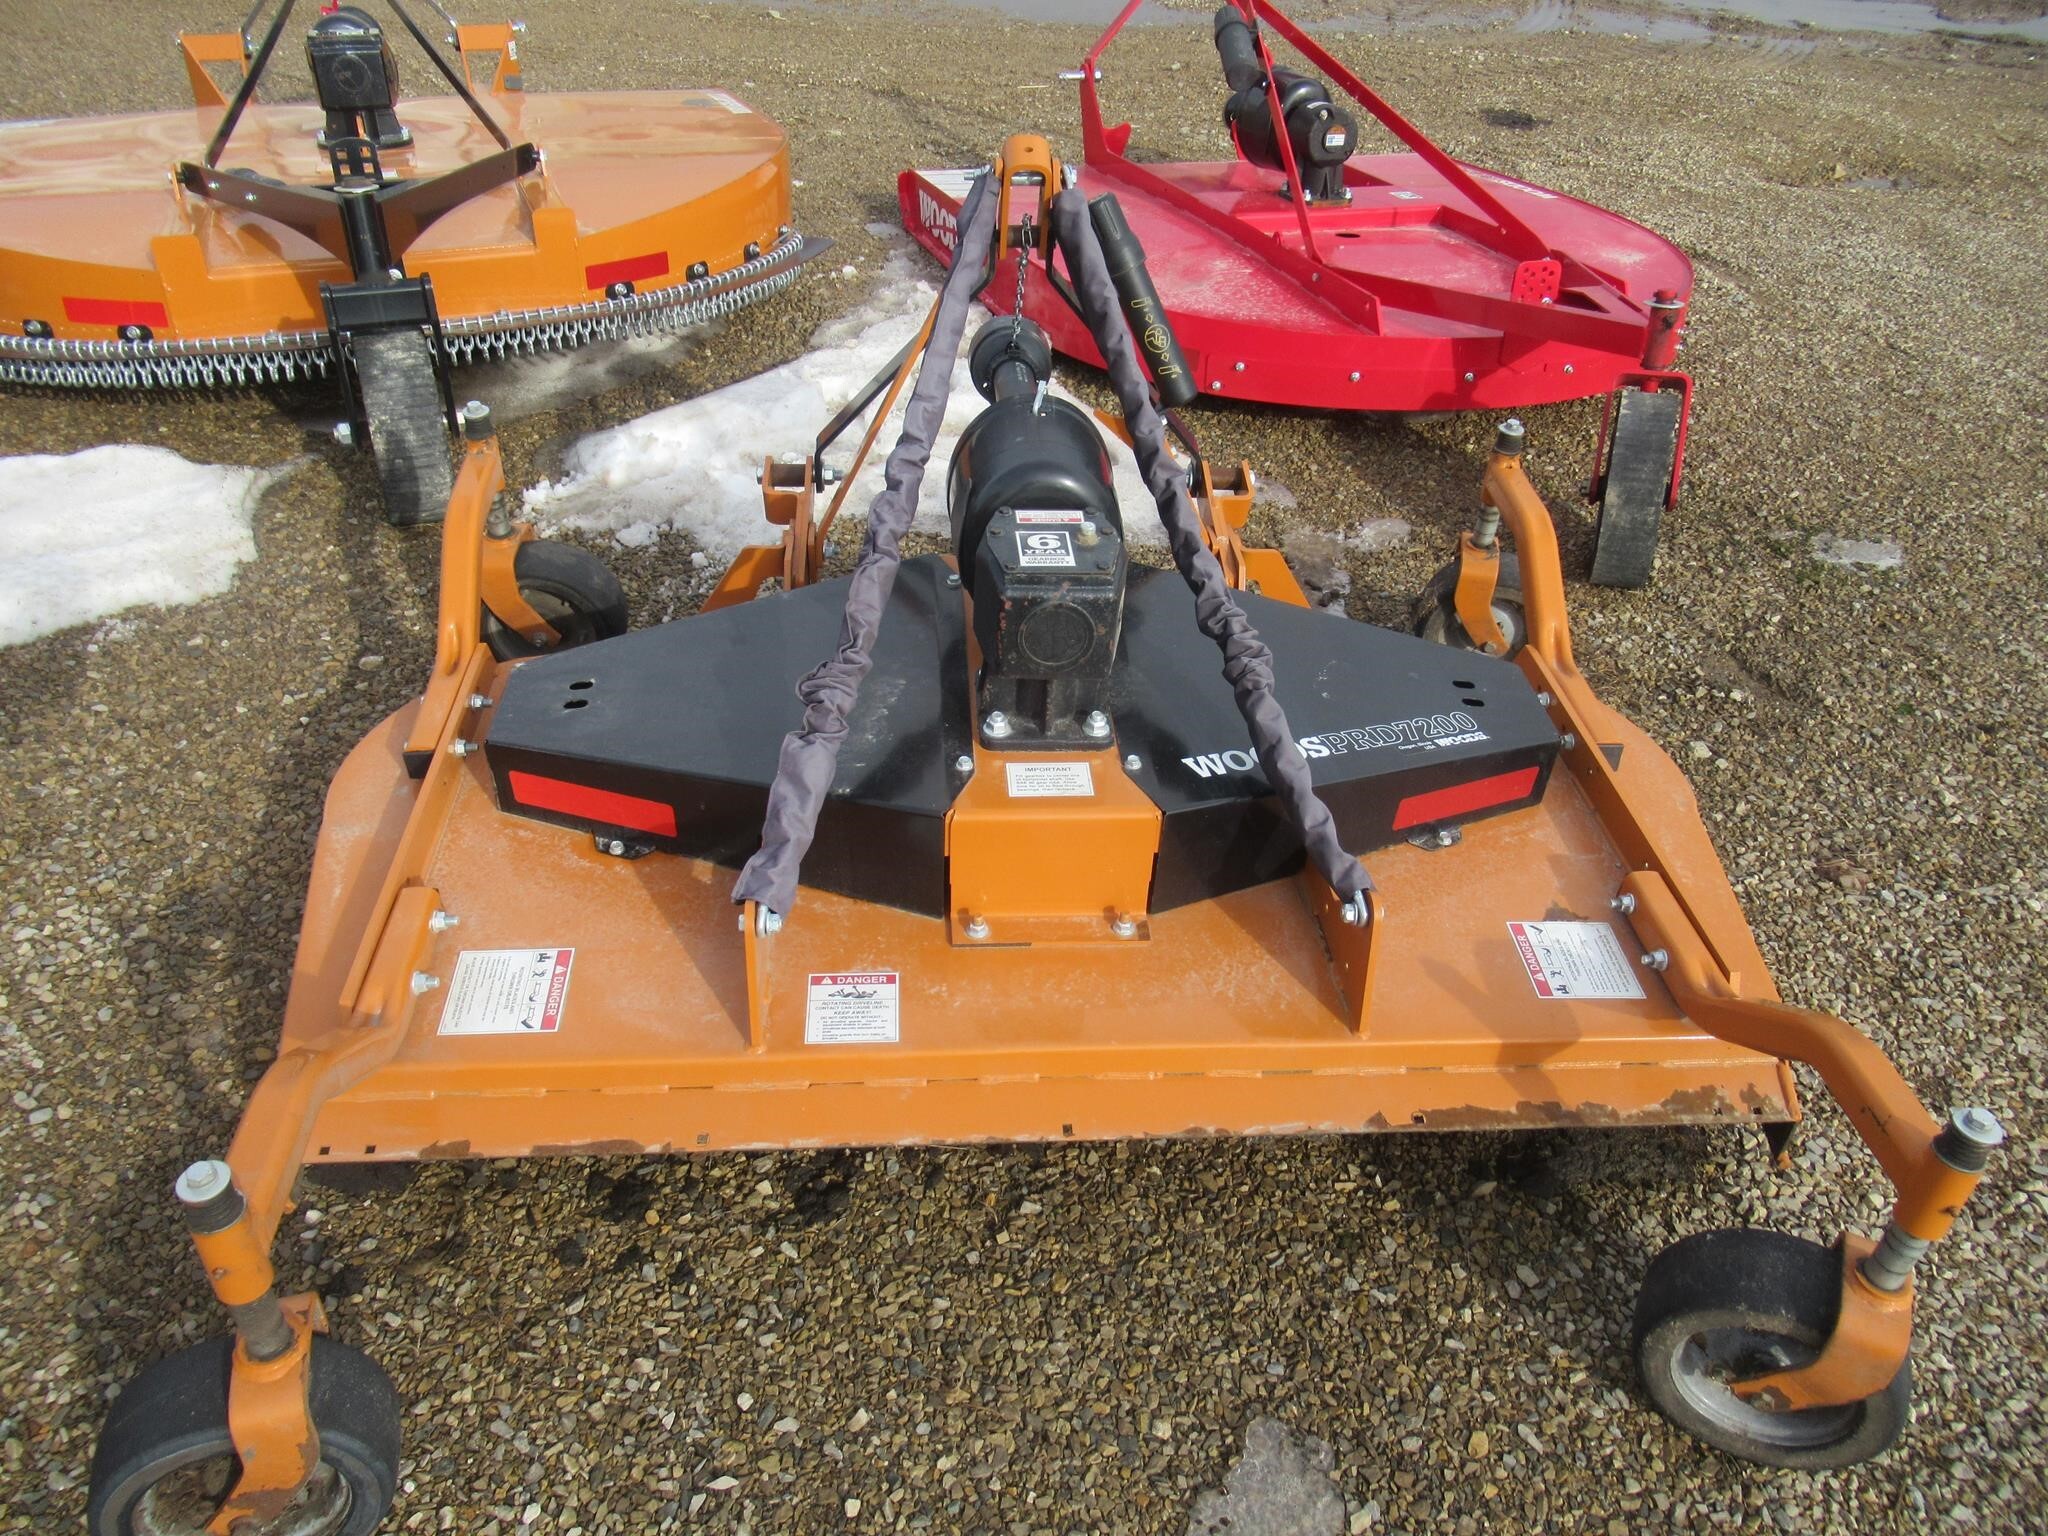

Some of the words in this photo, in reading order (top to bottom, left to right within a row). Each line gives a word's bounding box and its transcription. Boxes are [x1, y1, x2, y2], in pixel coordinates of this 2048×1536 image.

[919, 188, 958, 250] WOOD
[1027, 534, 1061, 549] 6
[1181, 737, 1331, 778] WOS
[1320, 711, 1478, 754] PRD7200
[1516, 935, 1540, 970] DANGER
[545, 976, 563, 1015] DANGER
[837, 976, 887, 984] DANGER
